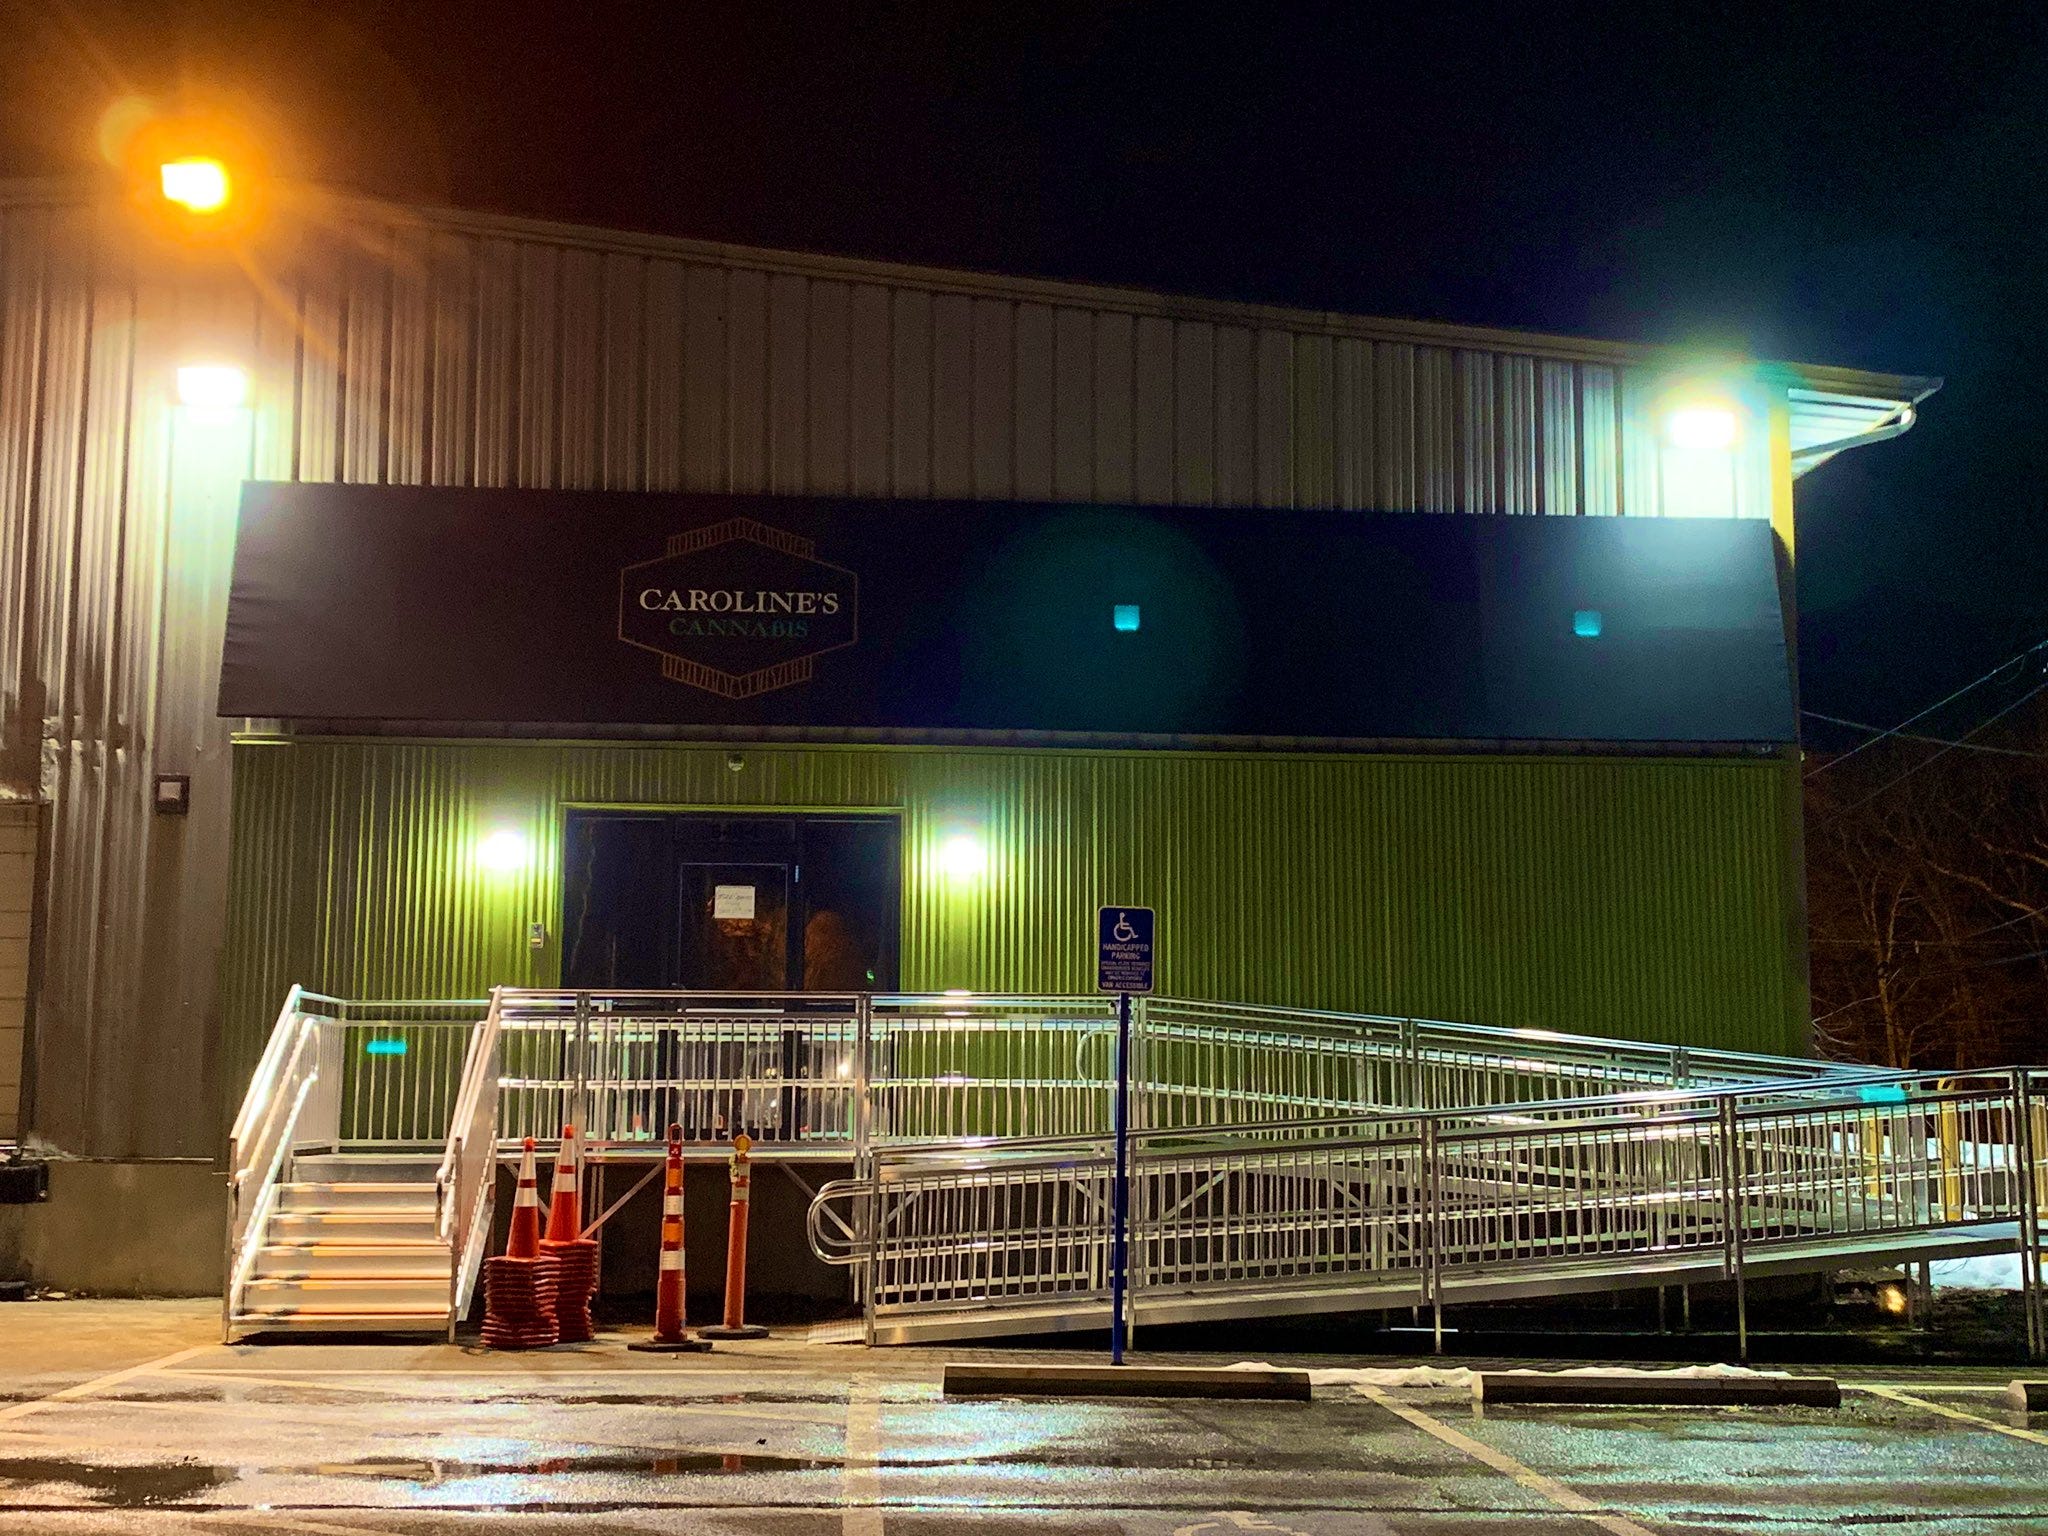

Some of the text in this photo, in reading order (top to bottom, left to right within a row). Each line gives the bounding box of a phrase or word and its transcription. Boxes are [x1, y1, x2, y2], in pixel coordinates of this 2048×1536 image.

[639, 588, 839, 615] CAROLINE'S
[669, 617, 808, 638] CANNABIS
[1102, 944, 1149, 952] HANDICAPPED
[1111, 952, 1141, 960] PARKING
